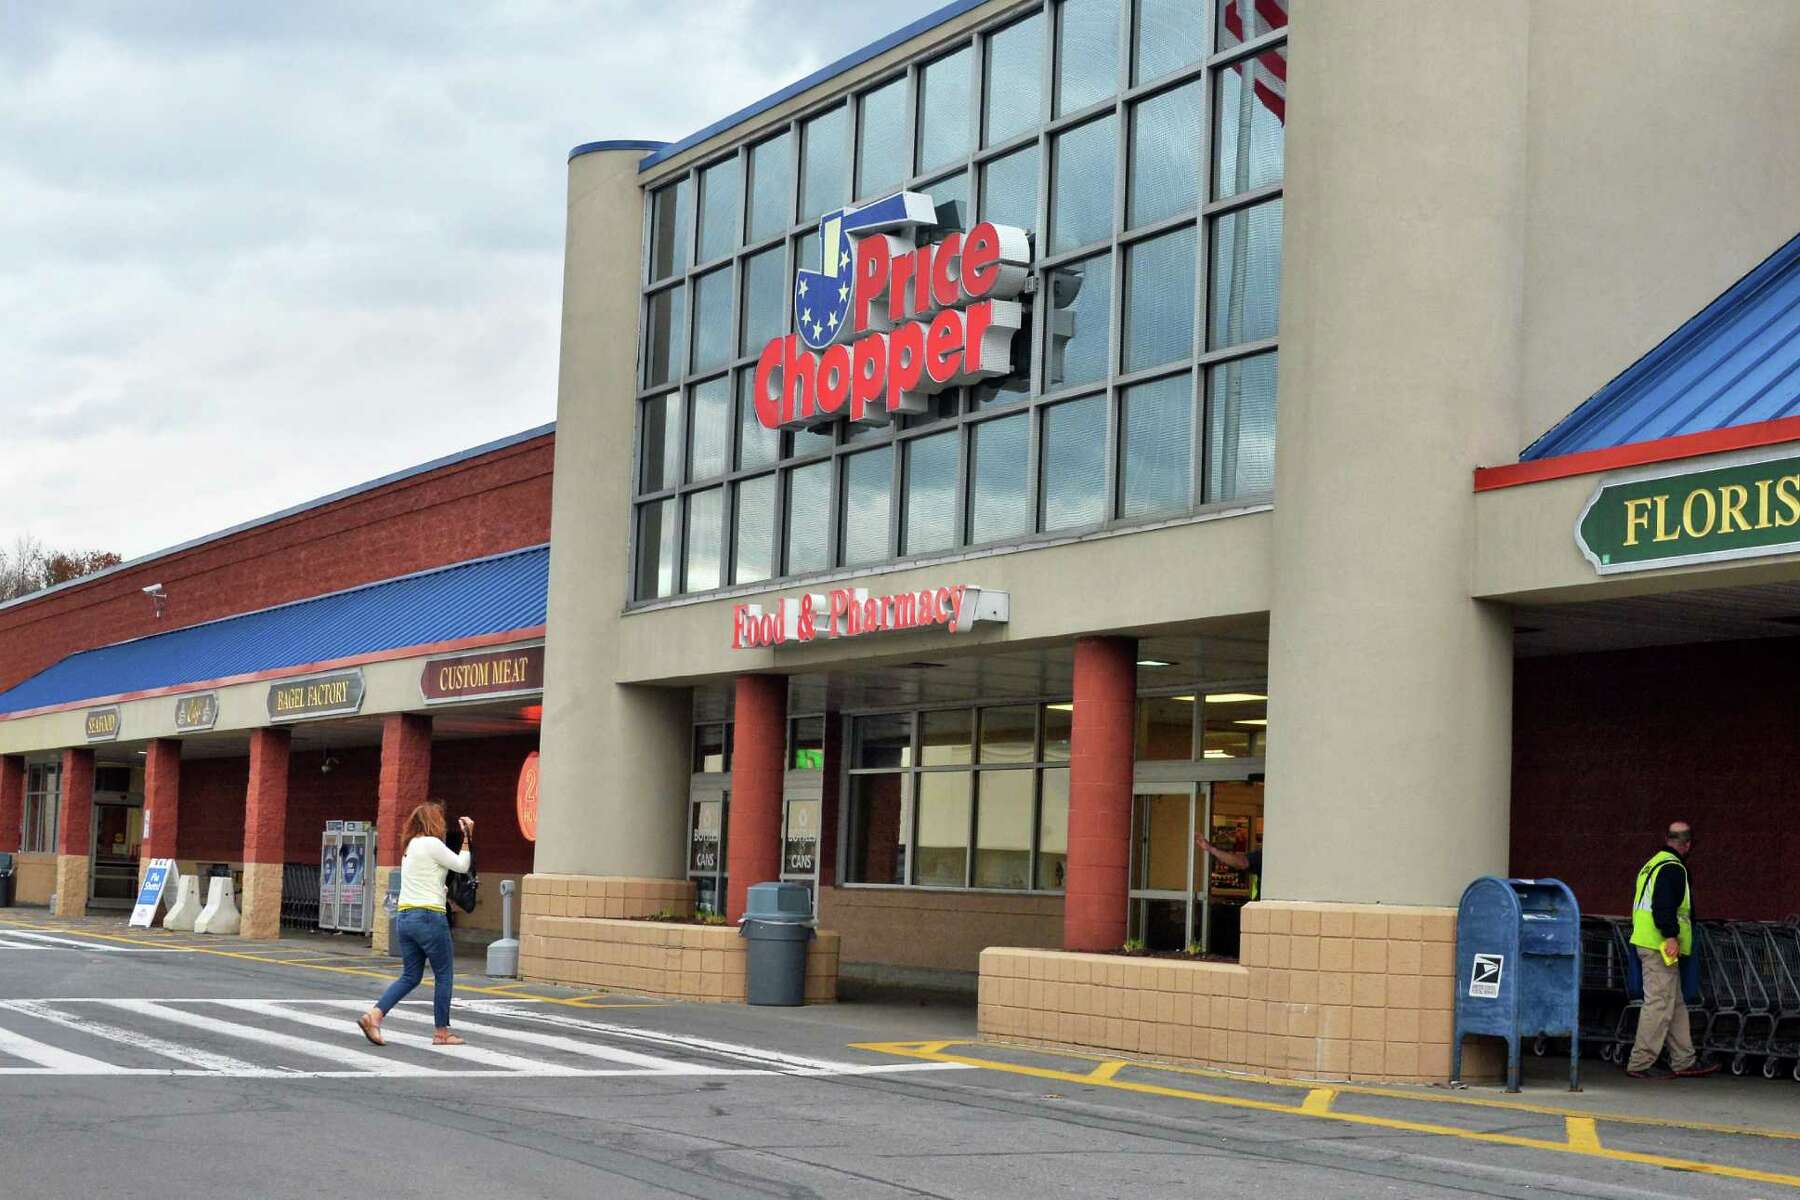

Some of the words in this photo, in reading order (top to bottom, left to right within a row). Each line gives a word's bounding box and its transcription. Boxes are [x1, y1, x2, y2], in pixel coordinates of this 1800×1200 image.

[854, 221, 1001, 333] Price
[754, 300, 993, 430] Chopper
[732, 598, 786, 650] Food
[798, 592, 817, 641] &
[829, 584, 967, 638] Pharmacy
[439, 661, 489, 691] CUSTOM
[492, 657, 528, 685] MEAT
[277, 687, 305, 711] BAGEL
[307, 680, 349, 707] FACTORY
[696, 853, 715, 867] CANS
[790, 854, 812, 869] CANS
